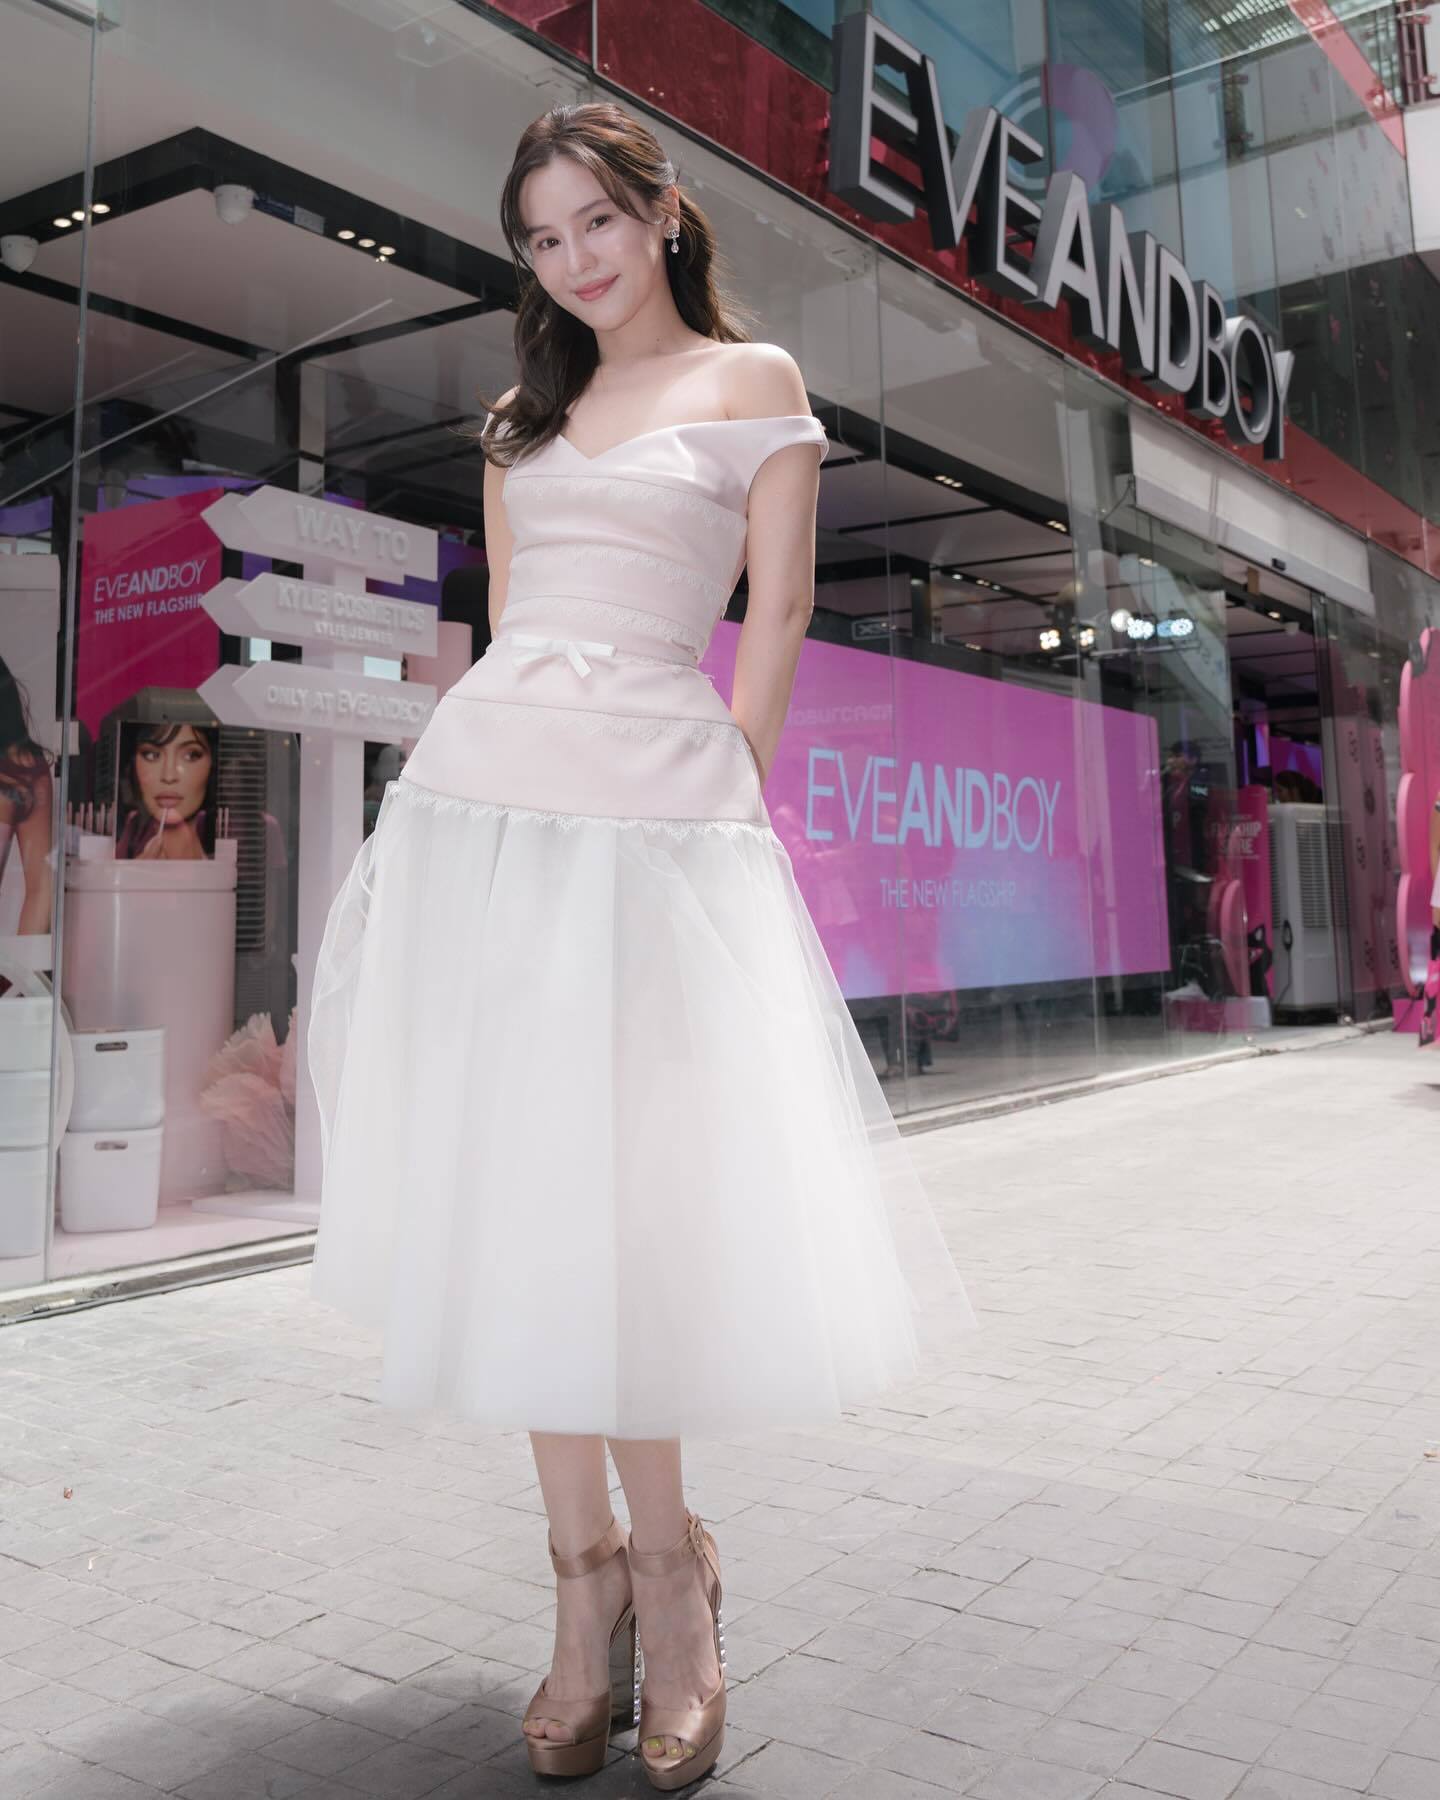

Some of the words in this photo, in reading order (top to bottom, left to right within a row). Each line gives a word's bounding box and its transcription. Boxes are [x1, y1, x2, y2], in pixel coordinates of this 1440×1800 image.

[828, 12, 1295, 460] EVEANDBOY
[296, 504, 367, 553] WAY
[372, 525, 411, 562] TO
[94, 558, 207, 603] EVEANDBOY
[95, 608, 115, 624] THE
[118, 602, 144, 622] NEW
[276, 580, 329, 614] KYLIE
[332, 591, 426, 635] COSMETICS
[266, 684, 309, 706] ONLY
[312, 690, 334, 711] AT
[806, 747, 1061, 857] EVEANDBOY
[880, 878, 908, 908] THE
[912, 879, 949, 909] NEW
[952, 880, 1016, 908] FLAGSHIP
